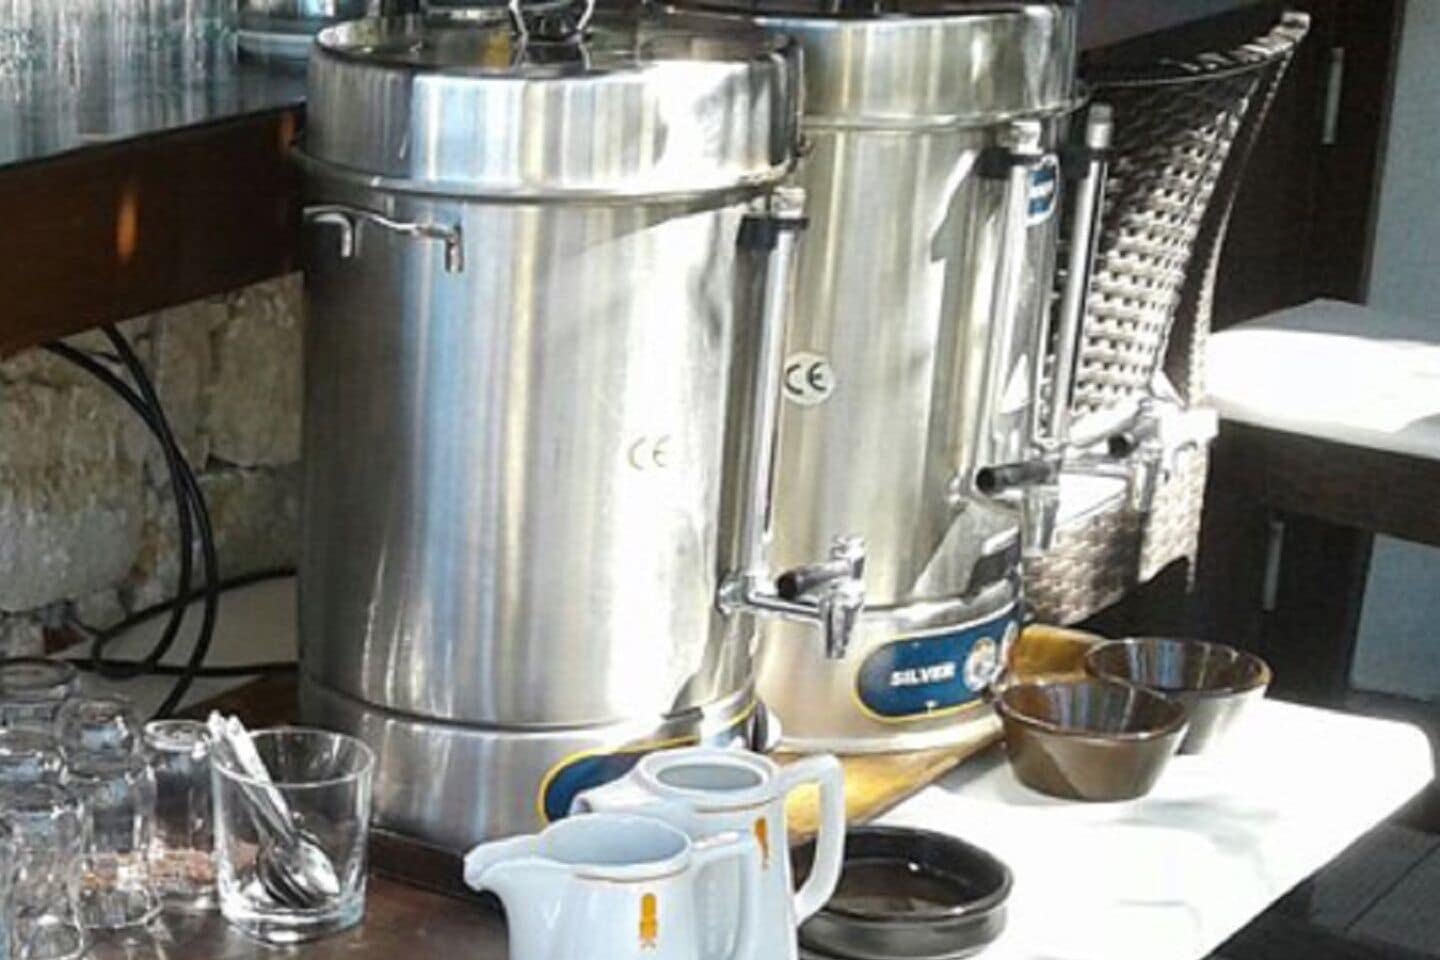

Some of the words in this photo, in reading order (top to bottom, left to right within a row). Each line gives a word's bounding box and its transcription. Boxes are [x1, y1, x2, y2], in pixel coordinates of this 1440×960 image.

[784, 361, 827, 395] CE
[628, 434, 671, 471] CE
[890, 661, 956, 687] SILVER
